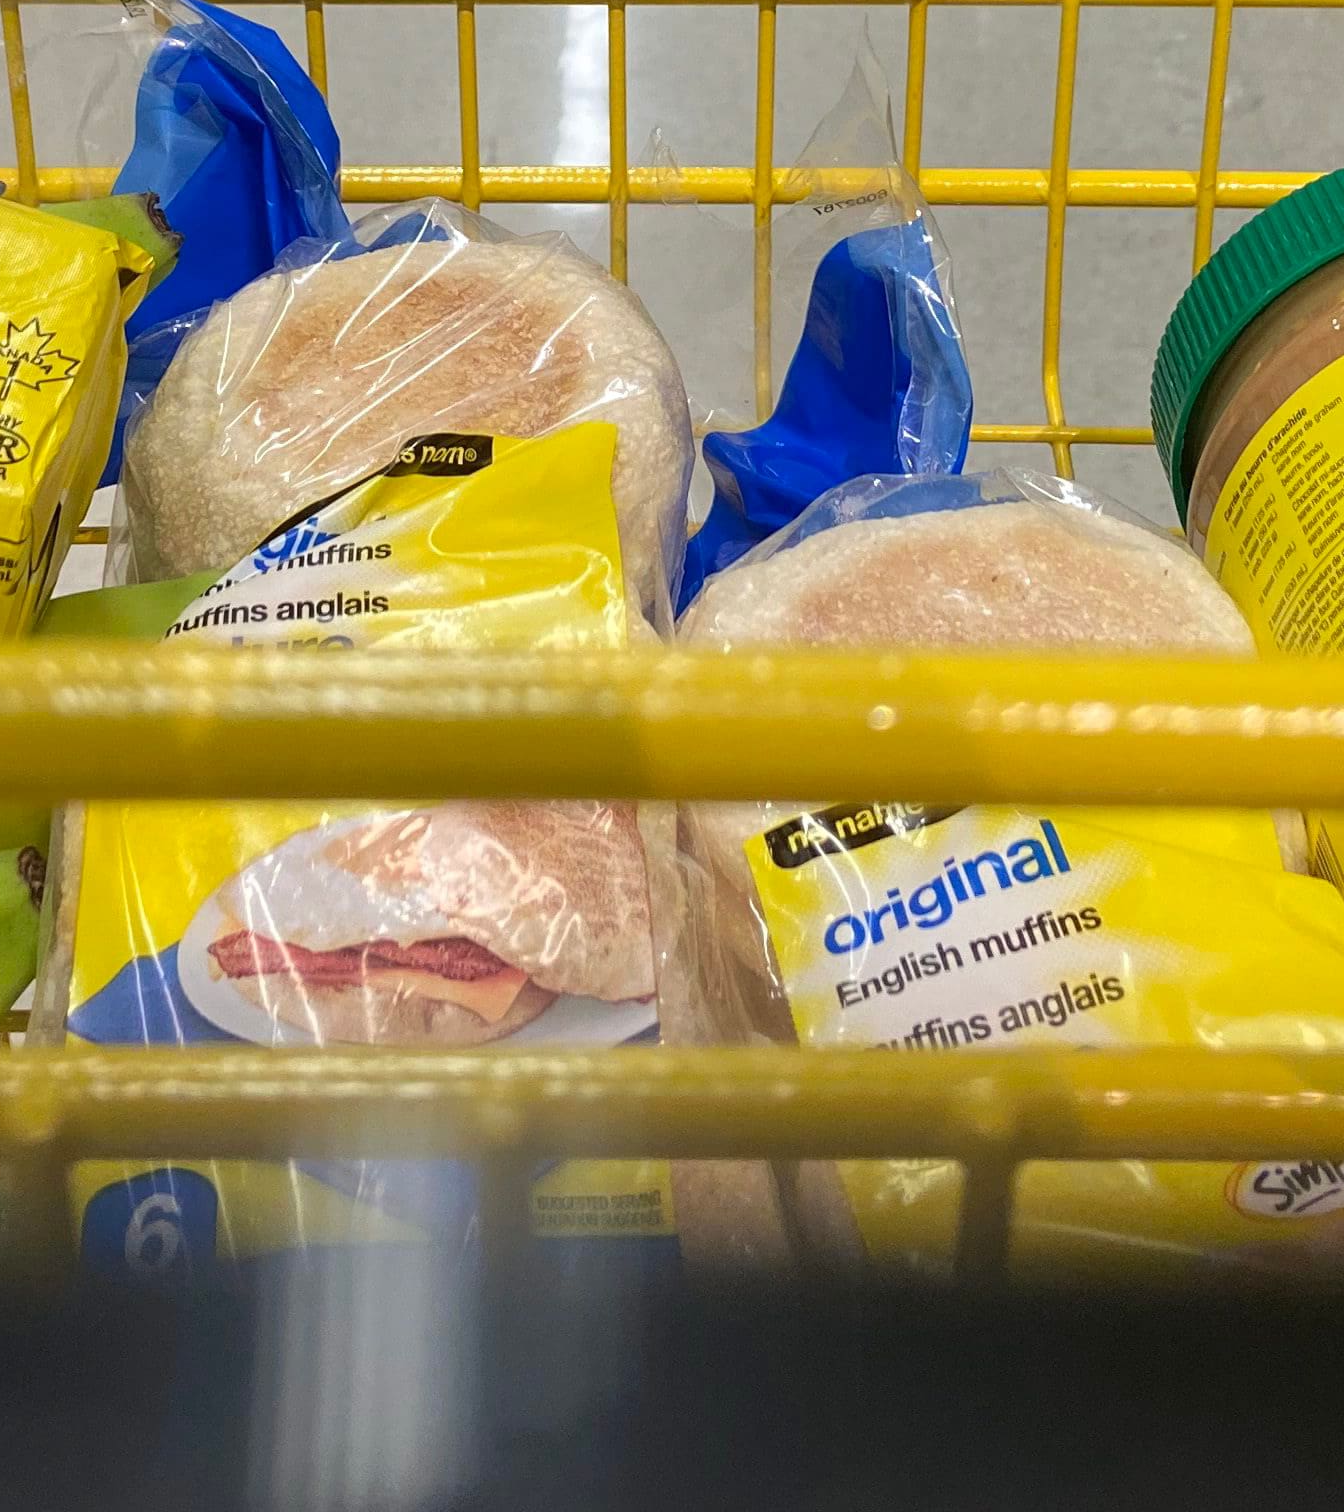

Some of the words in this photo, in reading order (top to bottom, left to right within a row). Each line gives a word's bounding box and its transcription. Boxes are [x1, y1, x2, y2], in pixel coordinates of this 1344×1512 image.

[277, 591, 390, 623] anglais
[823, 818, 1072, 956] original
[835, 943, 964, 1009] English
[970, 906, 1102, 963] muffins
[997, 972, 1126, 1028] anglais
[125, 1191, 183, 1273] 6
